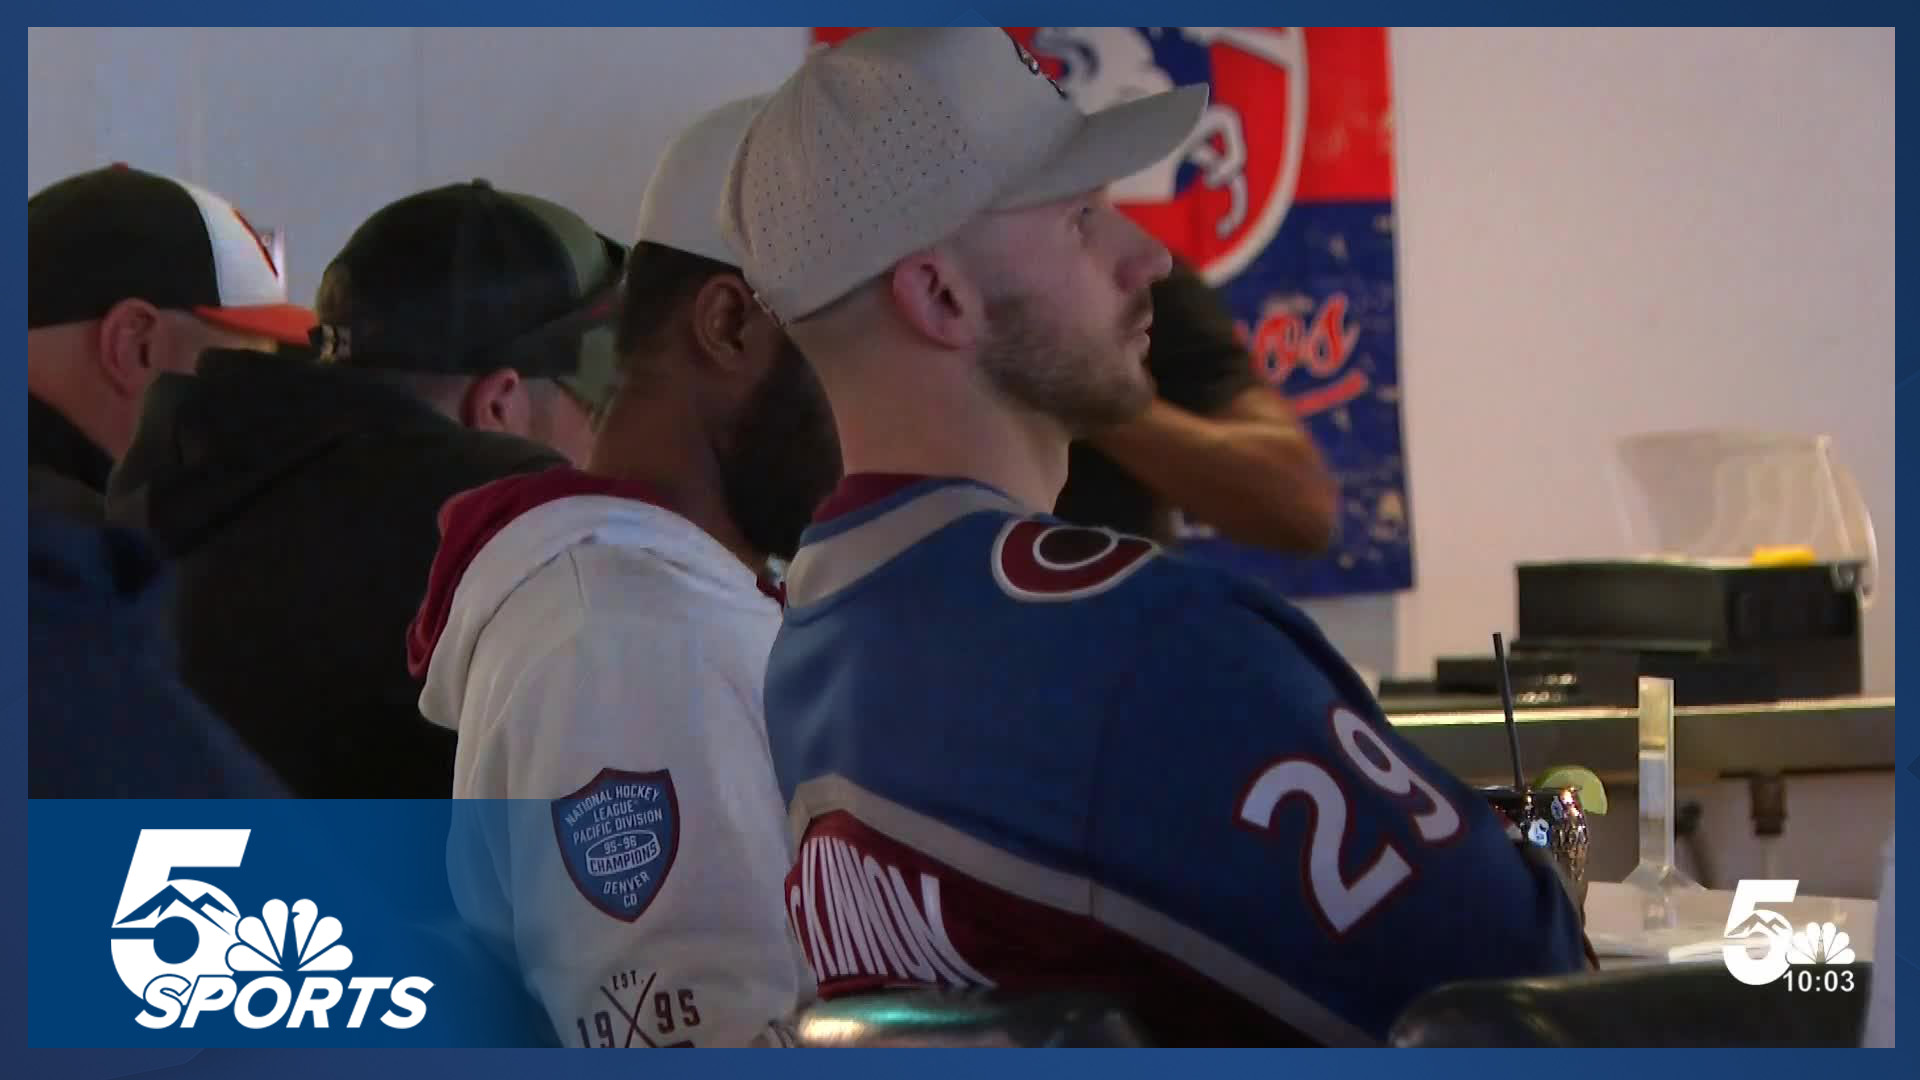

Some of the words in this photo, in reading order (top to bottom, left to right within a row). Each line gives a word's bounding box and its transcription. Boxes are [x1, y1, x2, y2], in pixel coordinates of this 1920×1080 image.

[564, 790, 612, 827] NATIONAL
[615, 785, 660, 803] HOCKEY
[593, 800, 634, 823] LEAGUE
[572, 821, 612, 846] PACIFIC
[615, 807, 663, 831] DIVISION
[1237, 705, 1464, 936] 29
[590, 840, 657, 873] CHAMPIONS
[603, 835, 637, 855] 95-96
[603, 871, 650, 895] DENVER
[623, 892, 638, 909] CO
[612, 969, 644, 991] EST.
